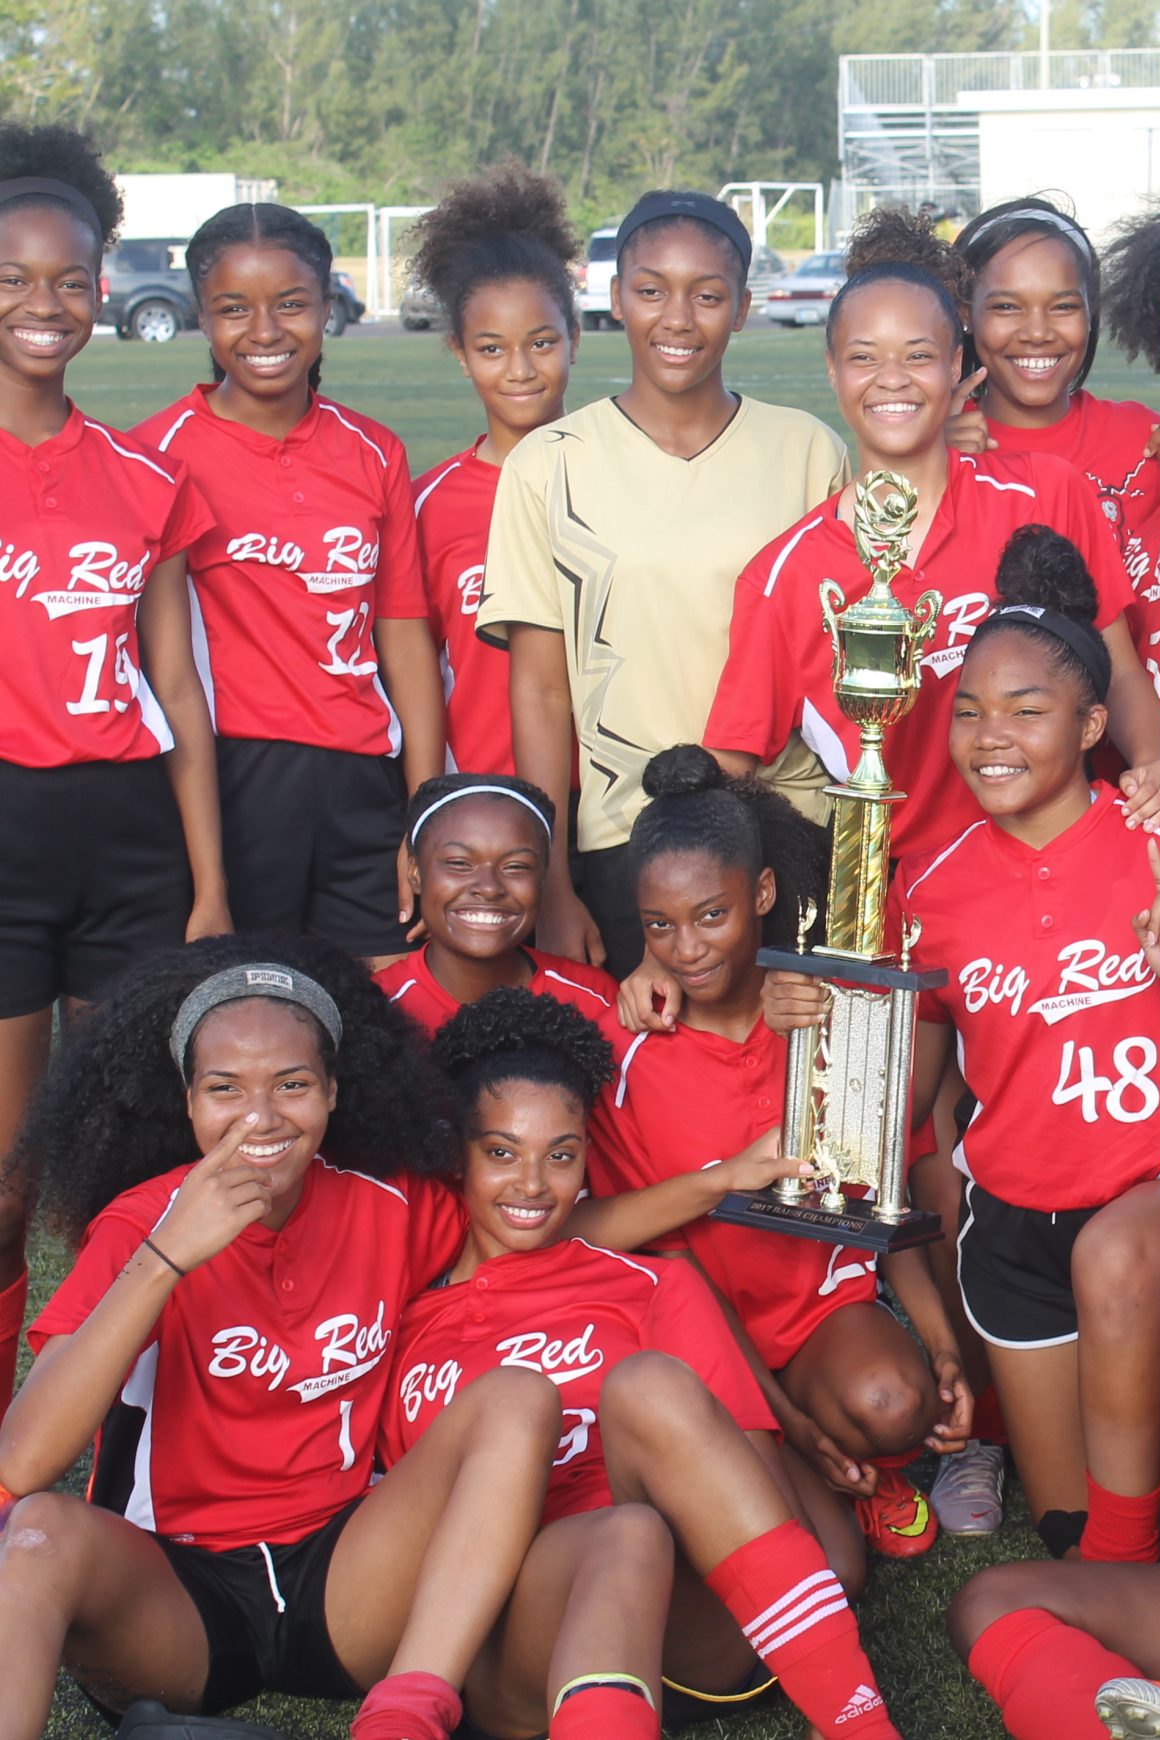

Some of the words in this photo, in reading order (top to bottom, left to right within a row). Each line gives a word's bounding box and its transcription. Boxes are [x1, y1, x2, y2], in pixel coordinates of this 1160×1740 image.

[0, 538, 41, 599] ig
[67, 541, 150, 592] Red
[226, 532, 305, 571] Big
[309, 575, 353, 585] MACHINE
[47, 595, 101, 605] MACHINE
[958, 957, 1031, 1017] Big
[1057, 939, 1151, 994] Red
[1041, 996, 1092, 1011] MACHINE
[1051, 1035, 1160, 1124] 48
[802, 1212, 863, 1230] CHAMPIONS
[208, 1325, 292, 1392] Big
[314, 1299, 393, 1374] Red
[303, 1371, 351, 1392] MACHINE
[401, 1358, 463, 1423] Big
[496, 1323, 598, 1374] Red
[338, 1400, 355, 1472] 1
[835, 1696, 883, 1724] adidas
